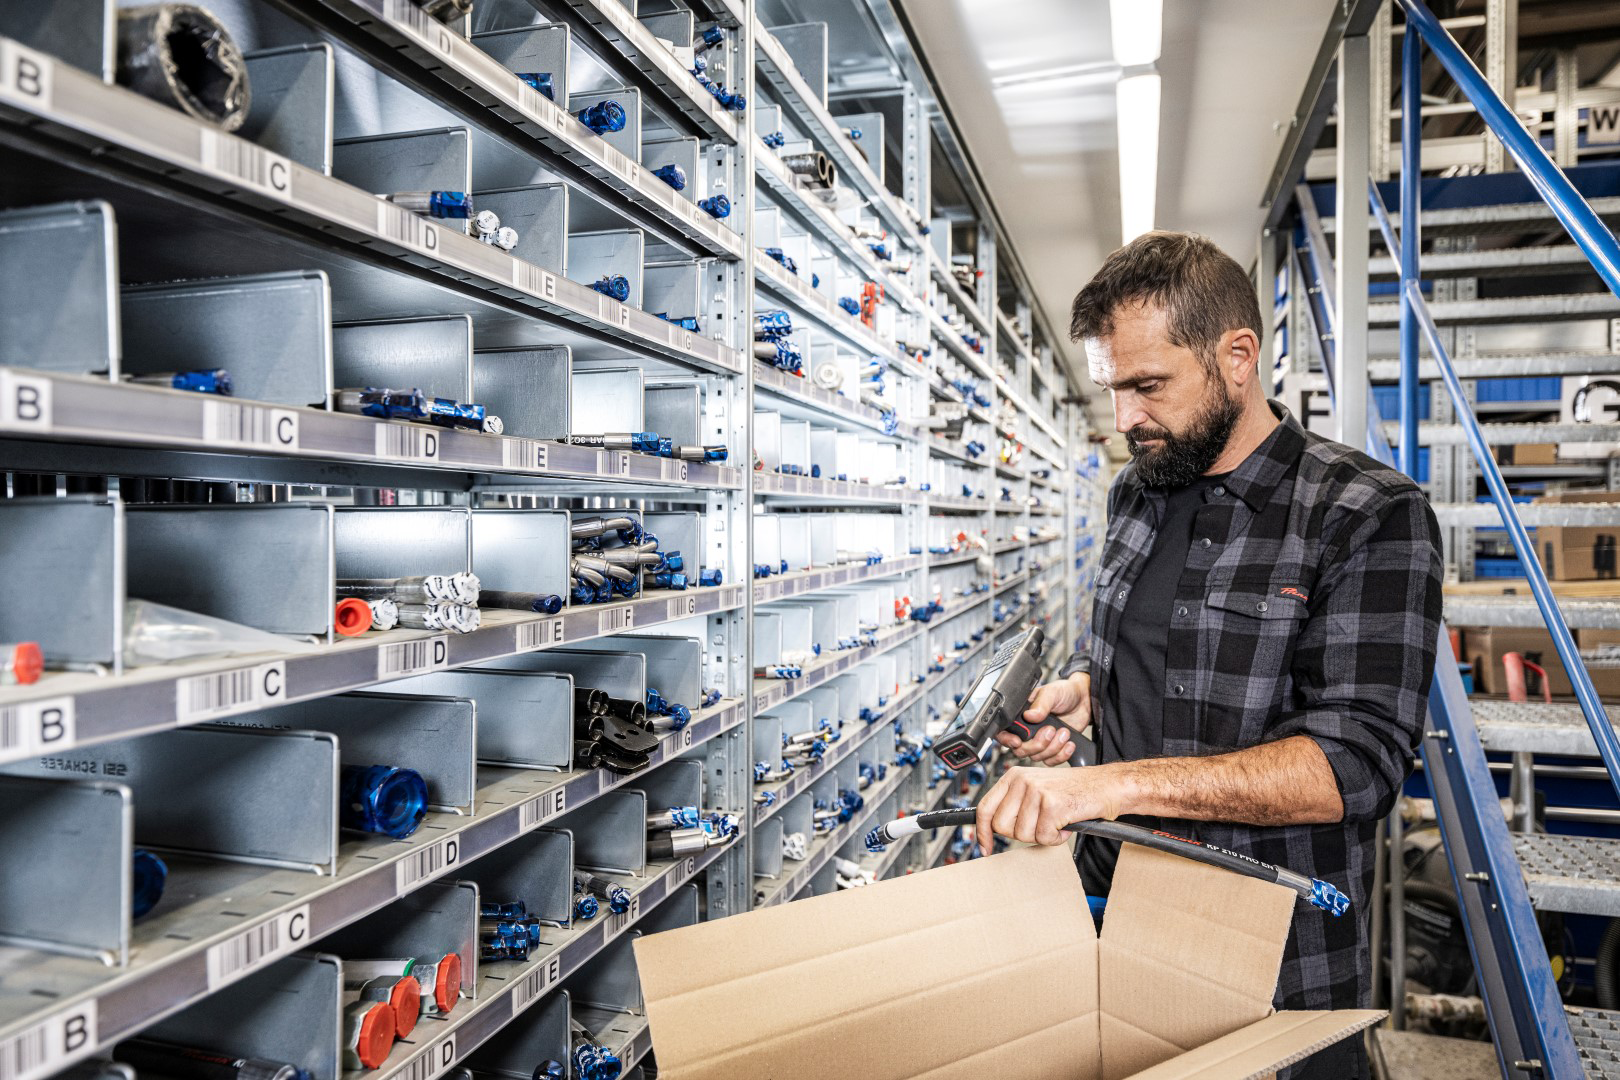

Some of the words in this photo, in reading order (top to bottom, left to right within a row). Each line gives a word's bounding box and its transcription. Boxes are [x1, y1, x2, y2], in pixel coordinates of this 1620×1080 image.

[440, 29, 450, 54] D
[16, 56, 42, 97] B
[1593, 107, 1619, 131] W
[270, 162, 286, 191] C
[632, 165, 637, 181] F
[426, 225, 436, 250] D
[546, 276, 553, 297] E
[622, 308, 628, 325] F
[686, 335, 692, 350] G
[16, 385, 41, 421] B
[278, 417, 293, 444] C
[426, 434, 436, 458] D
[538, 447, 546, 468] E
[621, 456, 628, 474] F
[680, 464, 687, 480] G
[689, 598, 695, 614] G
[625, 609, 631, 626] F
[554, 622, 562, 641] E
[435, 641, 445, 664] D
[264, 668, 280, 696] C
[41, 708, 64, 743] B
[685, 730, 691, 746] G
[556, 791, 564, 813] E
[446, 841, 457, 866] D
[1221, 848, 1237, 857] 210
[1239, 854, 1259, 865] PRO
[688, 858, 694, 874] G
[631, 899, 638, 920] F
[289, 913, 304, 942] C
[550, 960, 557, 983] E
[64, 1014, 88, 1053] B
[442, 1041, 454, 1068] D
[625, 1046, 633, 1068] F
